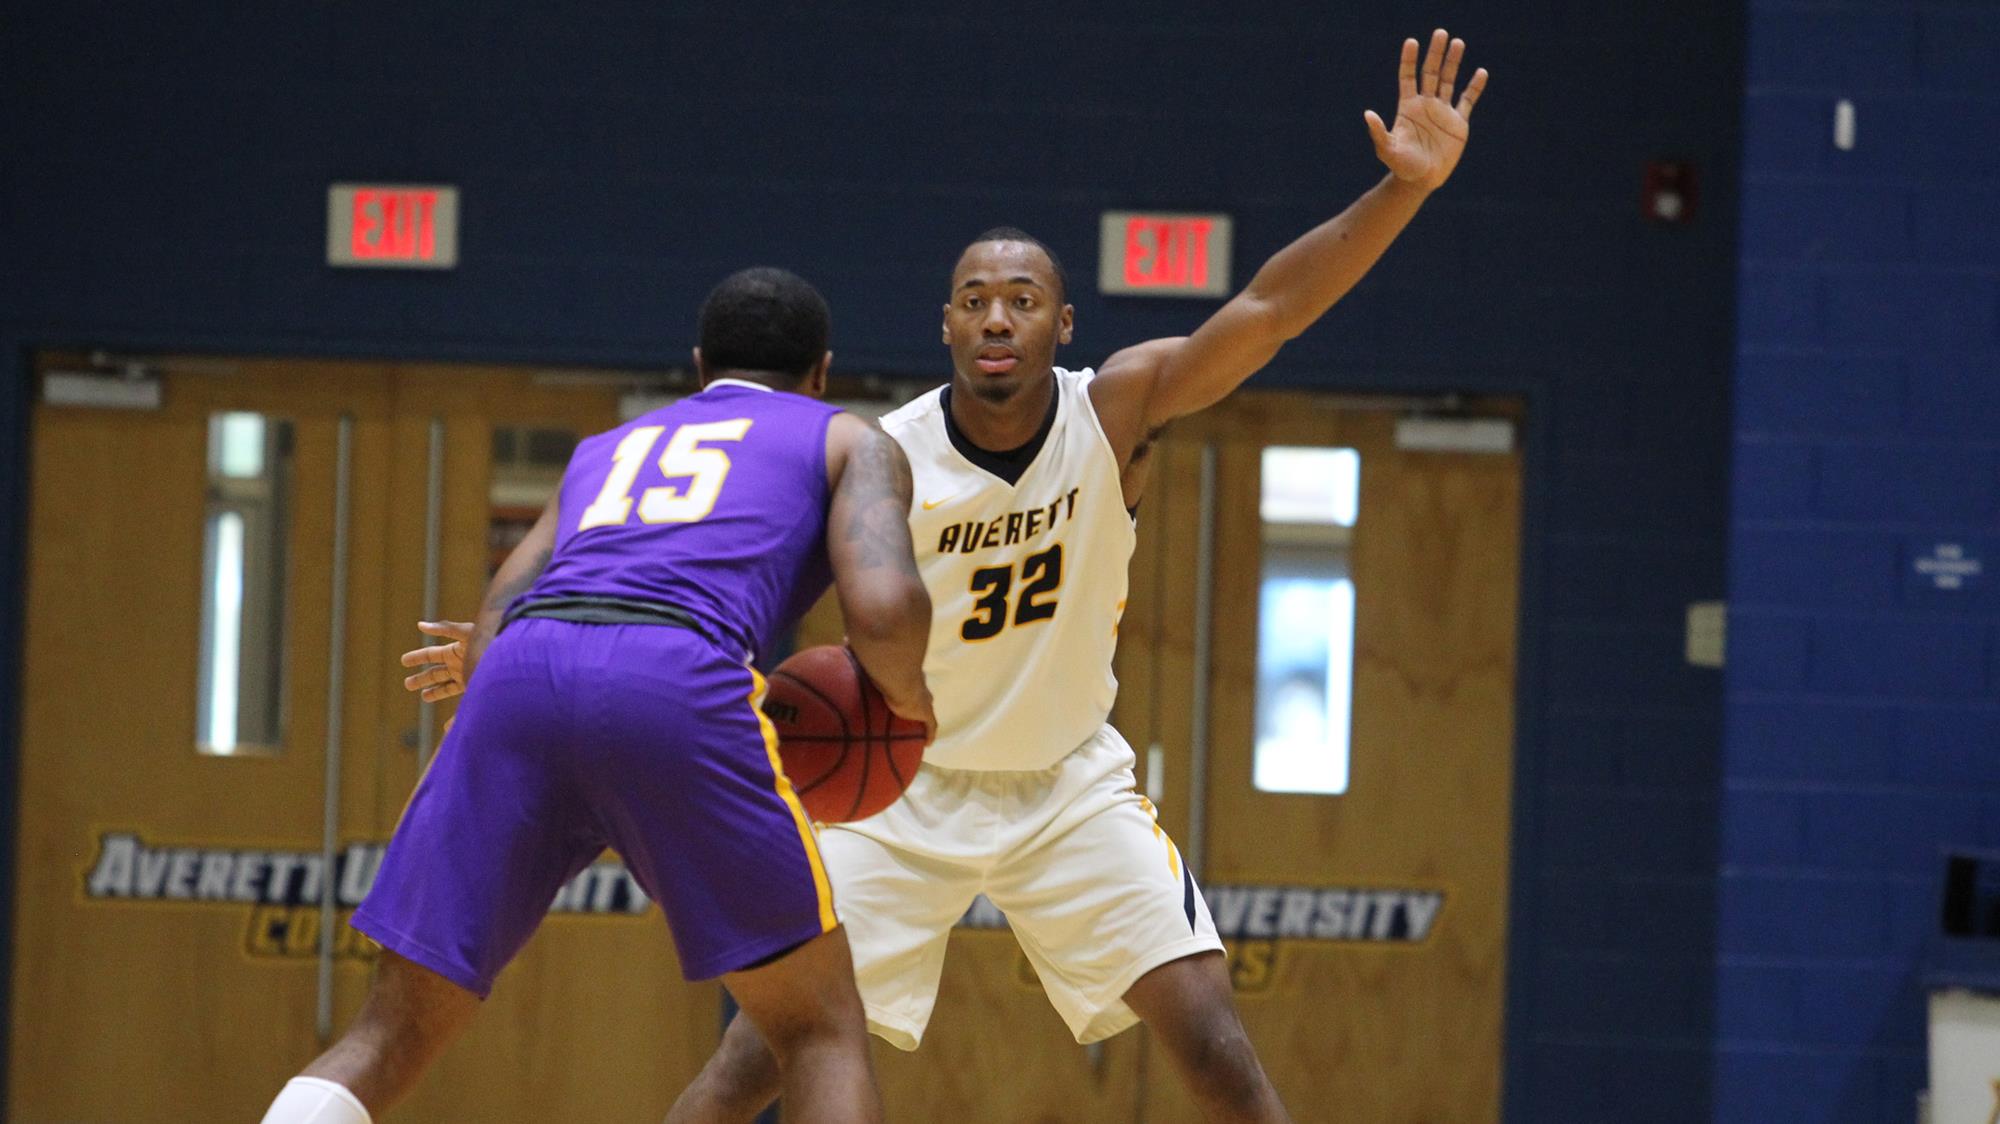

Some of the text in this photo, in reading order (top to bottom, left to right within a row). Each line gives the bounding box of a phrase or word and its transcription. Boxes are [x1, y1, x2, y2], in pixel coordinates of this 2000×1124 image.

[351, 187, 437, 259] EXIT
[1124, 215, 1213, 288] EXIT
[577, 418, 753, 532] 15
[937, 487, 1079, 553] AVERETT
[960, 541, 1062, 642] 32
[88, 834, 327, 898] AVERETT
[1205, 887, 1443, 942] VERSITY
